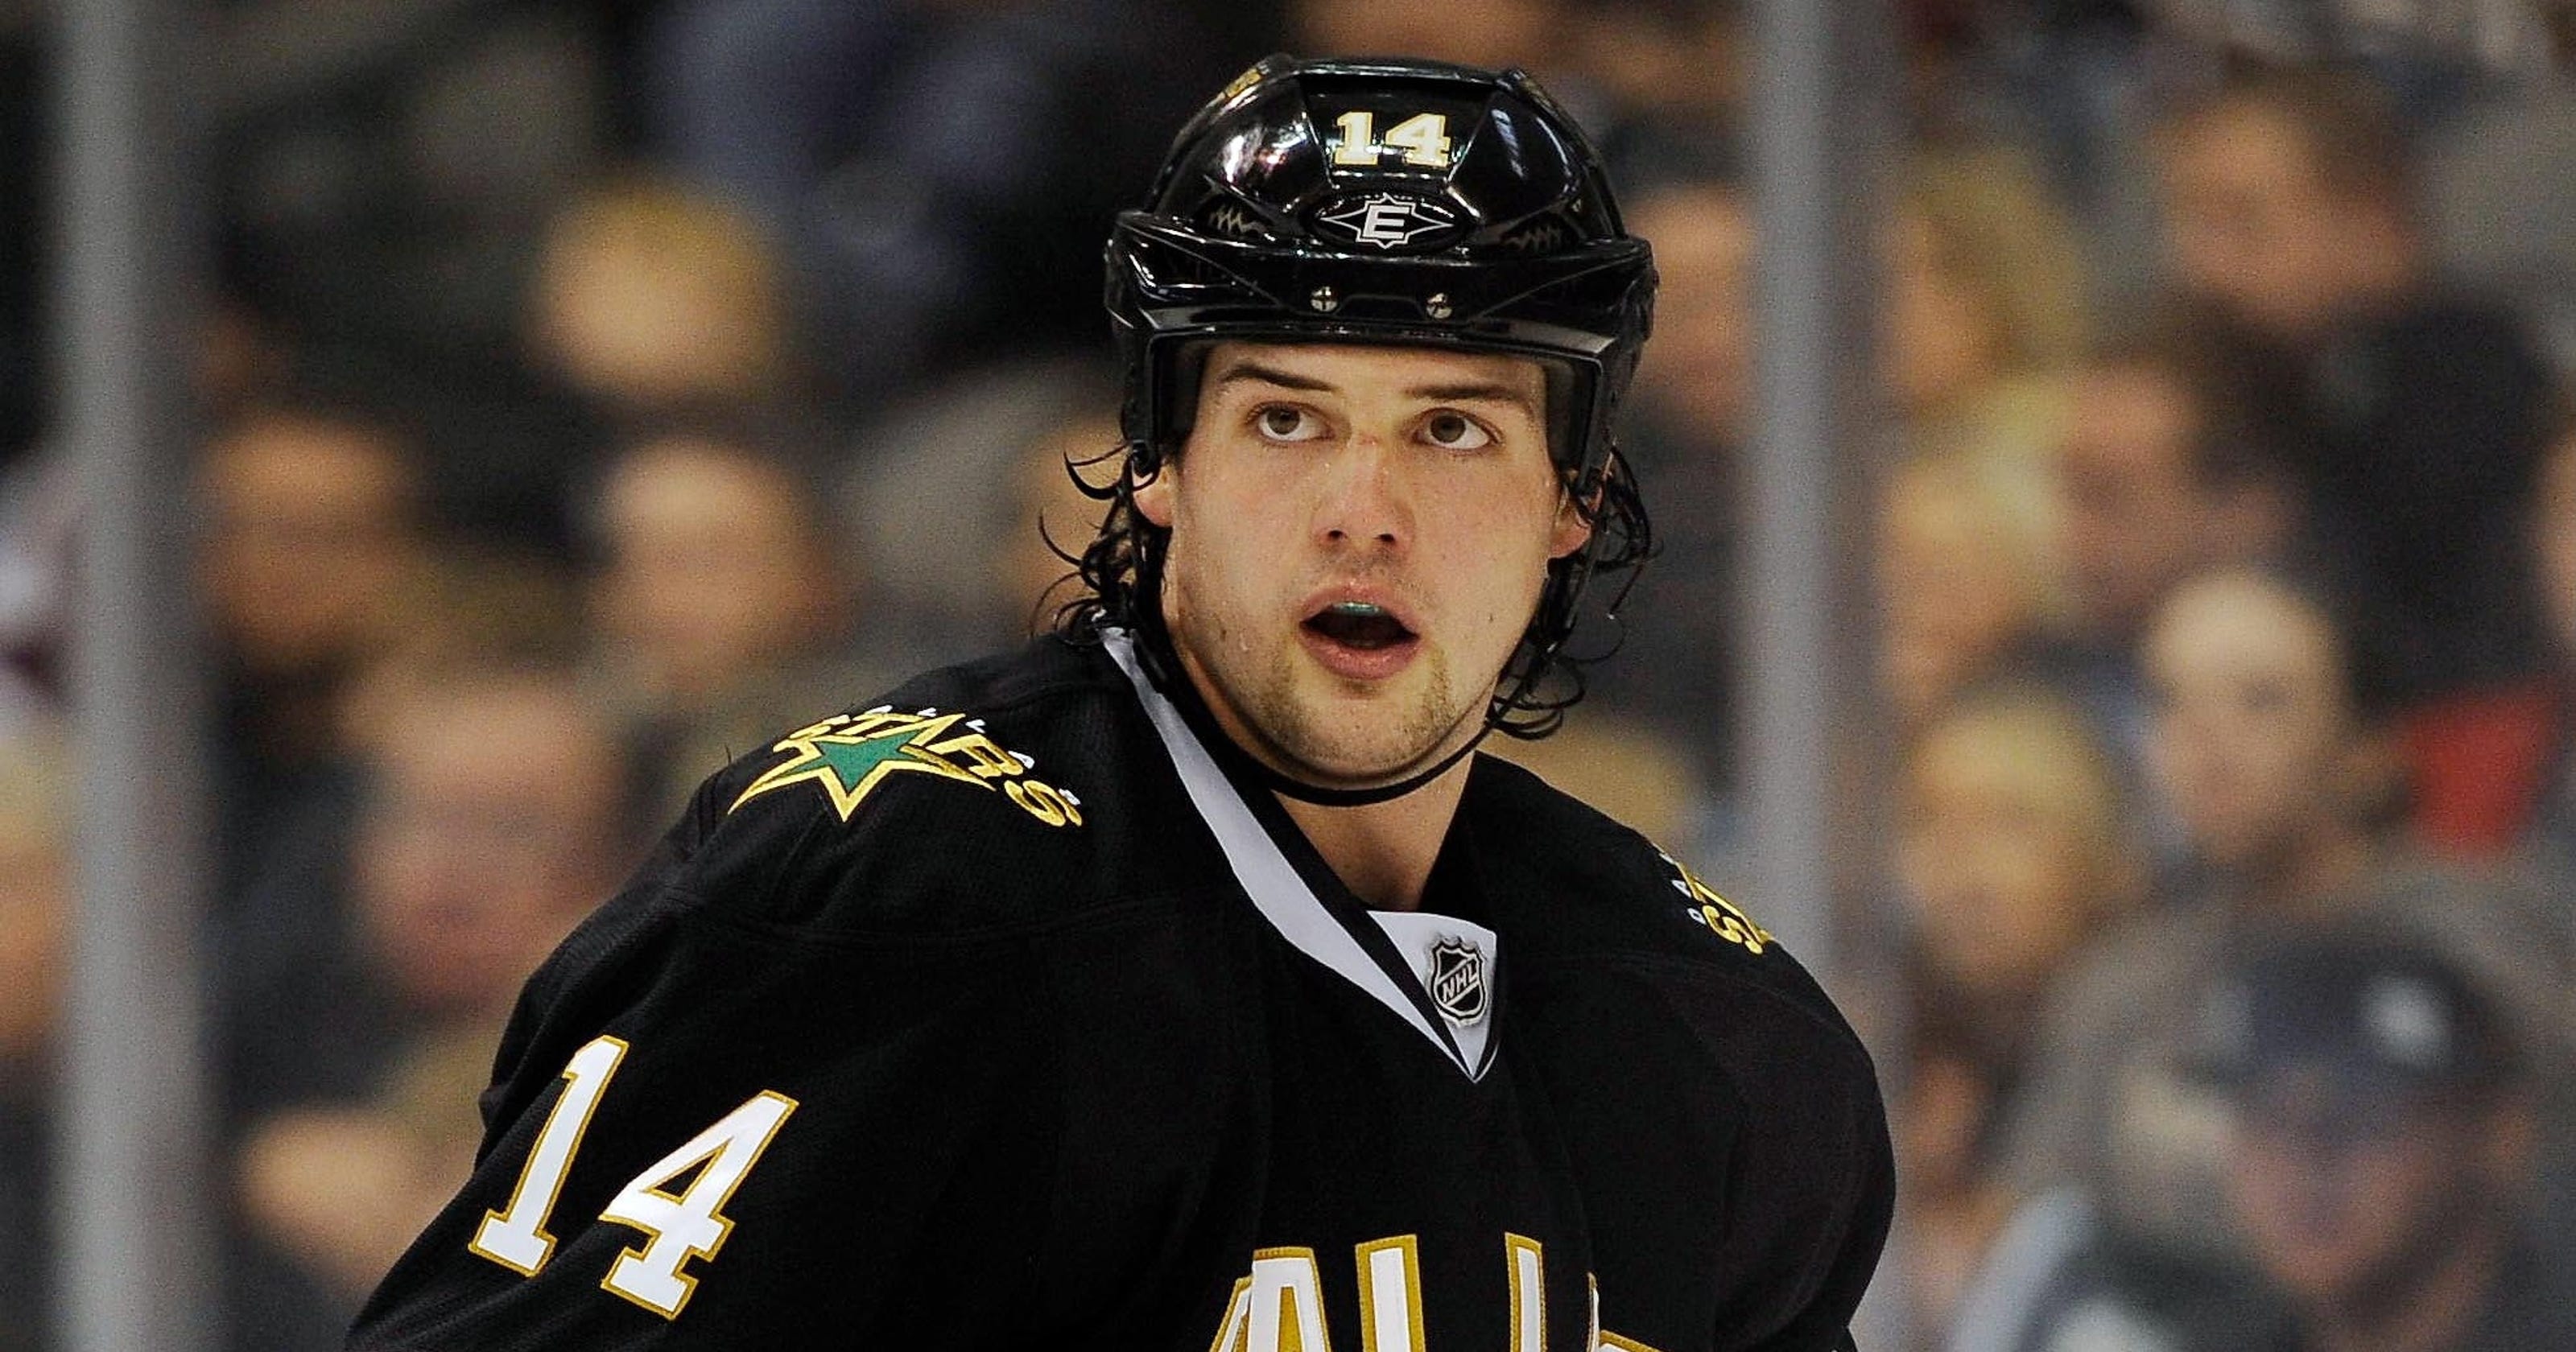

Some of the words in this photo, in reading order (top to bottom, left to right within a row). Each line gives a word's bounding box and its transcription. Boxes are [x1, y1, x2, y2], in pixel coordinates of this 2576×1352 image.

[1335, 111, 1451, 167] 14
[1362, 204, 1410, 239] E
[1441, 961, 1479, 1004] NHL
[467, 1034, 800, 1321] 14
